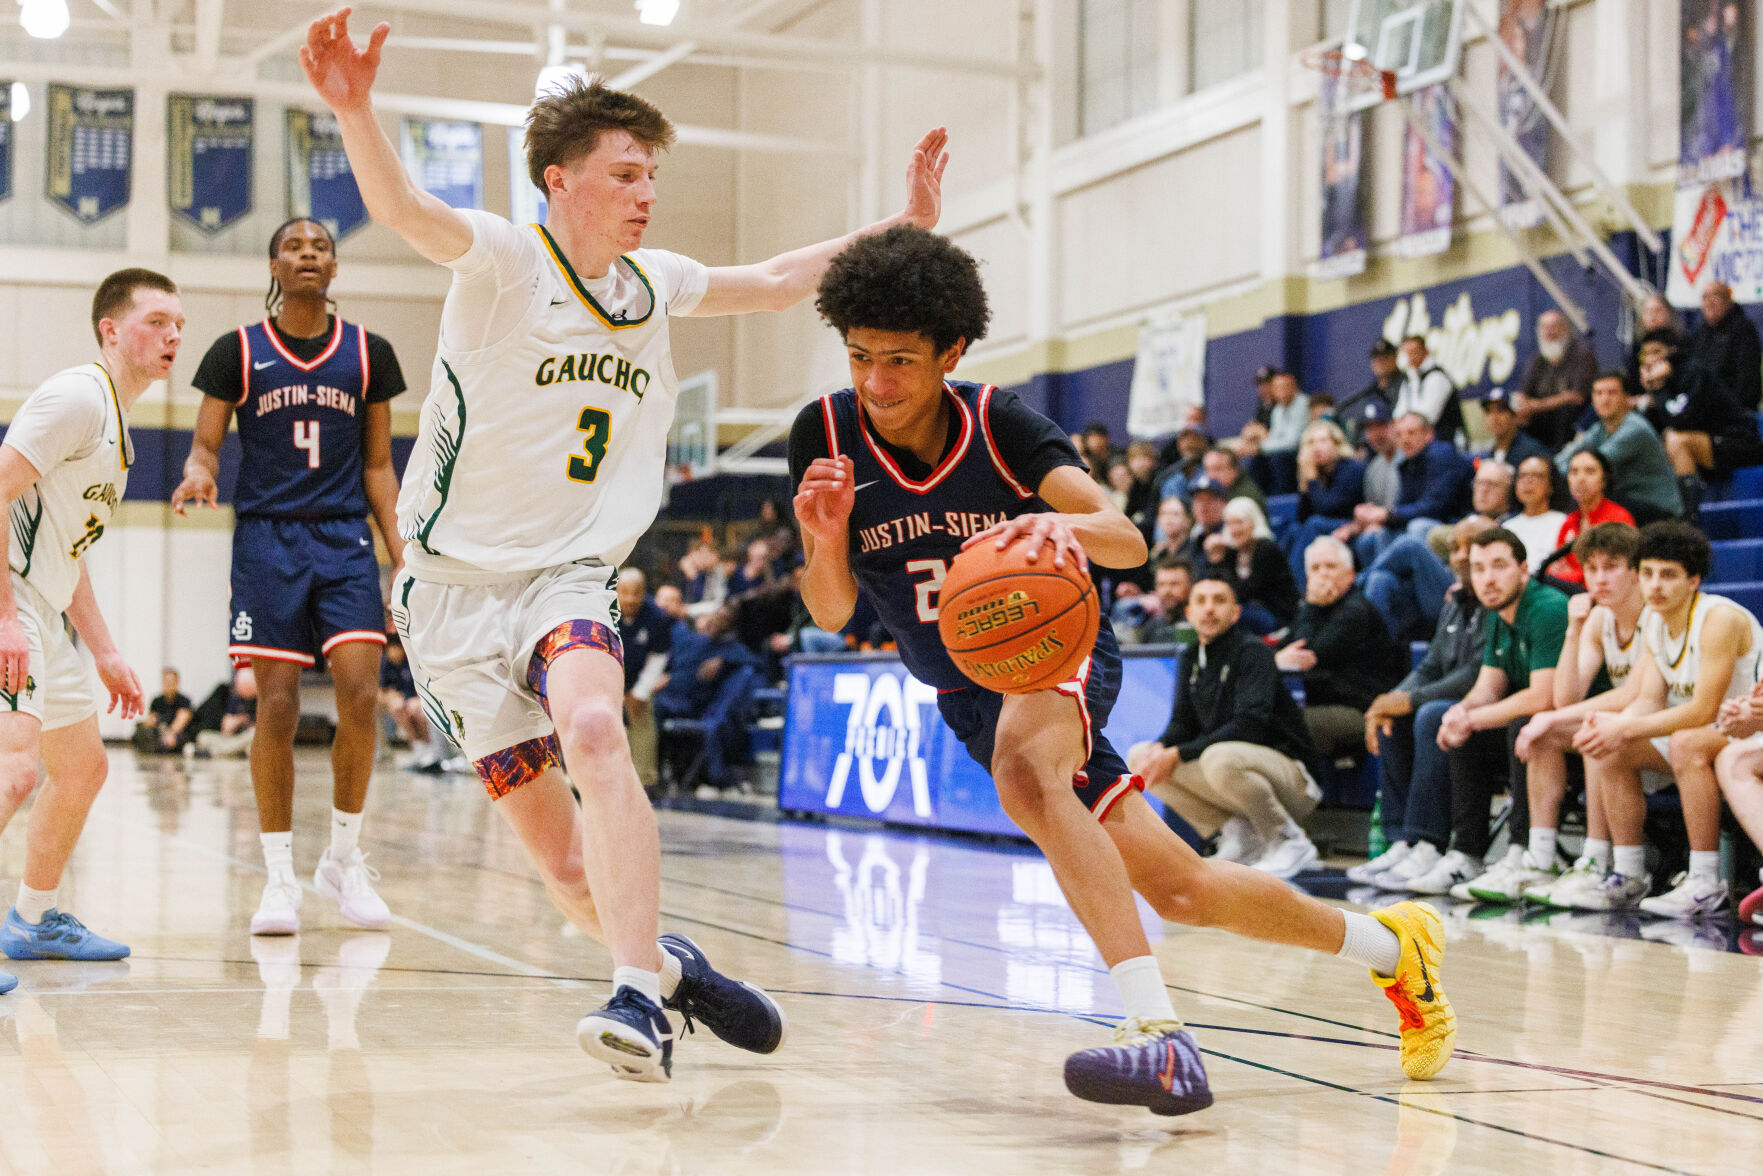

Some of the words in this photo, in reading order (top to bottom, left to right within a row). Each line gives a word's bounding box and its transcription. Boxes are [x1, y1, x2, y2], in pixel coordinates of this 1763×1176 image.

[256, 384, 356, 417] JUSTIN-SIENA
[293, 420, 320, 468] 4
[566, 405, 612, 485] 3
[957, 600, 1040, 638] LEGACY
[963, 629, 1065, 678] SPALDING
